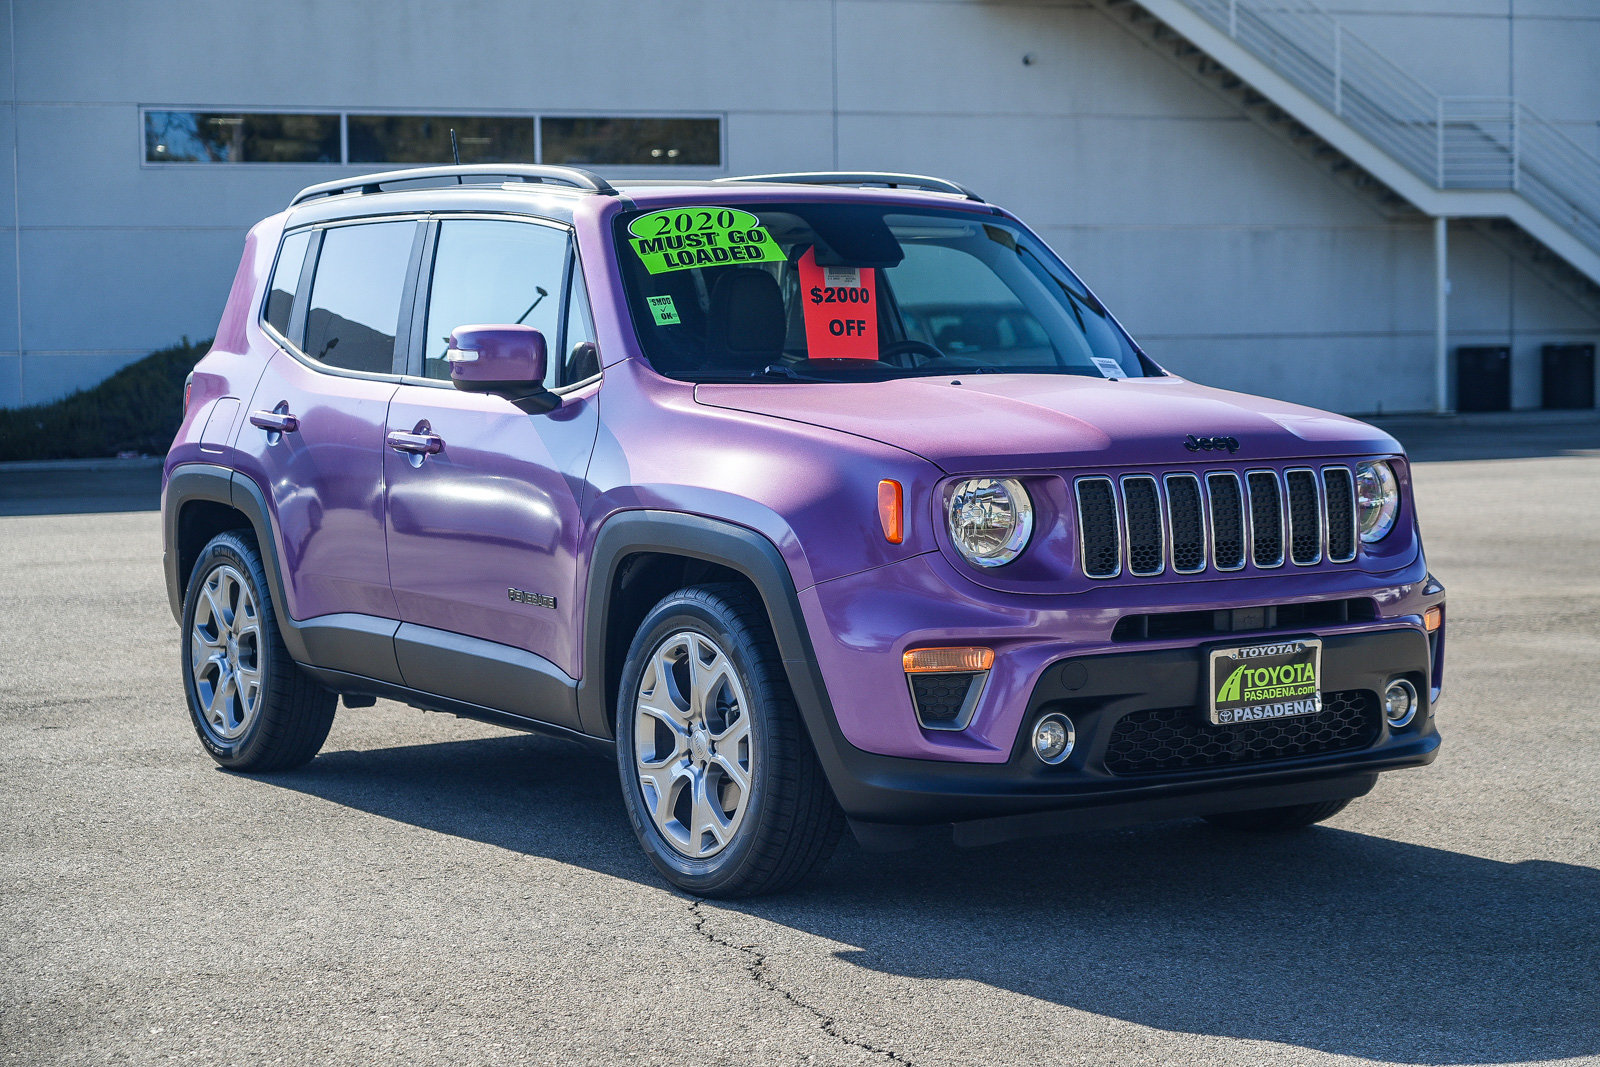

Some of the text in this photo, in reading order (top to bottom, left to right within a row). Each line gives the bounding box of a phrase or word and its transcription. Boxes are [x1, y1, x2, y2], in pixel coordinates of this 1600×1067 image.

[654, 210, 735, 236] 2020
[638, 229, 767, 255] MUST GO
[663, 245, 766, 269] LOADED
[651, 297, 672, 307] SMOG
[810, 285, 870, 306] $2000
[661, 312, 673, 320] OK
[829, 319, 866, 336] OFF
[1183, 434, 1240, 454] Jeep
[1240, 644, 1294, 658] TOYOTA
[1244, 663, 1315, 688] TOYOTA
[1244, 685, 1315, 702] PASADENA.com
[1233, 700, 1316, 722] PASADENA
